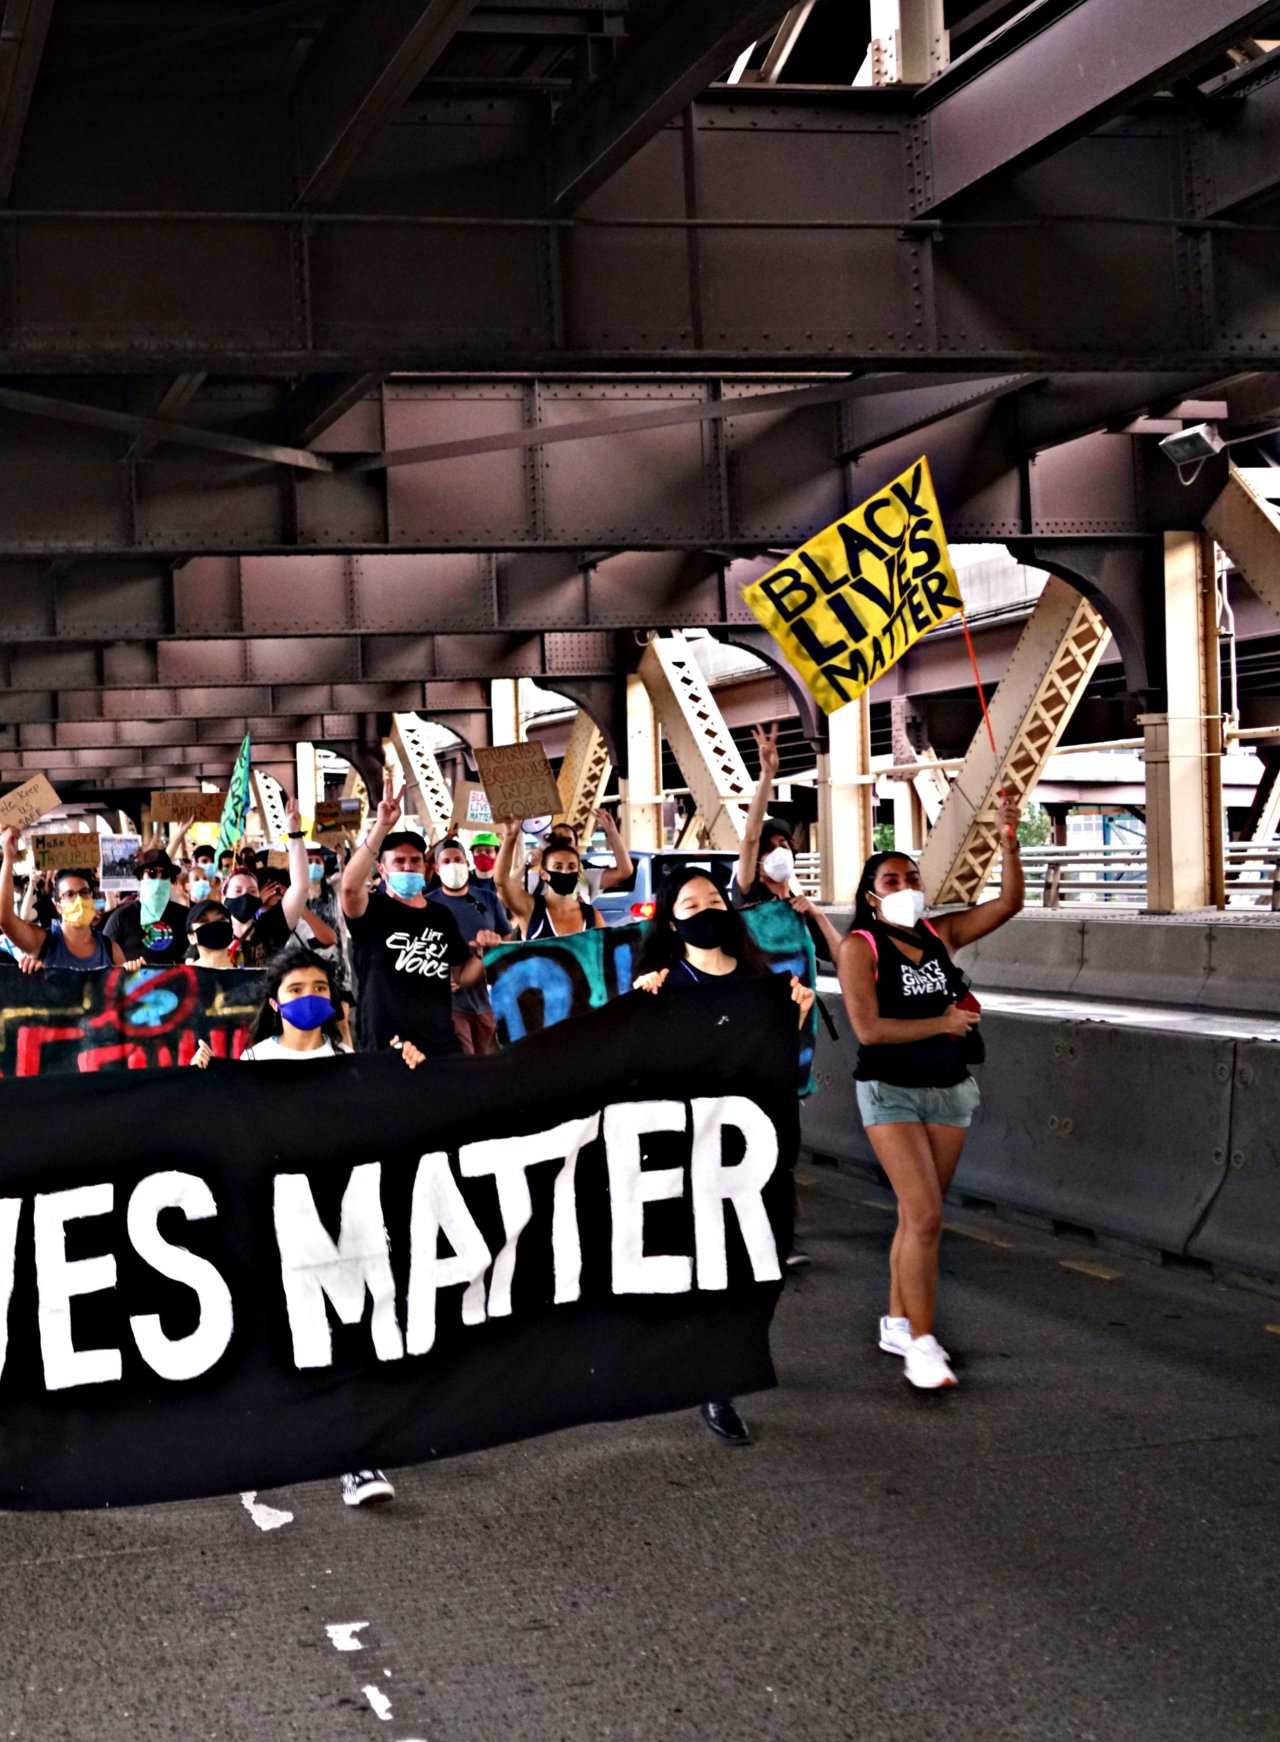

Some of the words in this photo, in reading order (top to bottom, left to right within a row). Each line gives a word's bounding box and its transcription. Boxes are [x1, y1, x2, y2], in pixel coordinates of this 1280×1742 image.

[759, 462, 929, 623] BLACK
[790, 518, 941, 667] LIVES
[821, 571, 964, 703] MATTER
[479, 743, 536, 765] FUND
[480, 760, 551, 787] SCHOOLS
[471, 792, 487, 803] BLA
[501, 780, 547, 800] NOT
[470, 802, 489, 812] LIVE
[496, 798, 552, 819] COPS
[385, 931, 449, 960] EVERY
[394, 949, 449, 979] VOICE
[902, 967, 946, 986] GIRLS
[272, 1094, 780, 1369] MATTER
